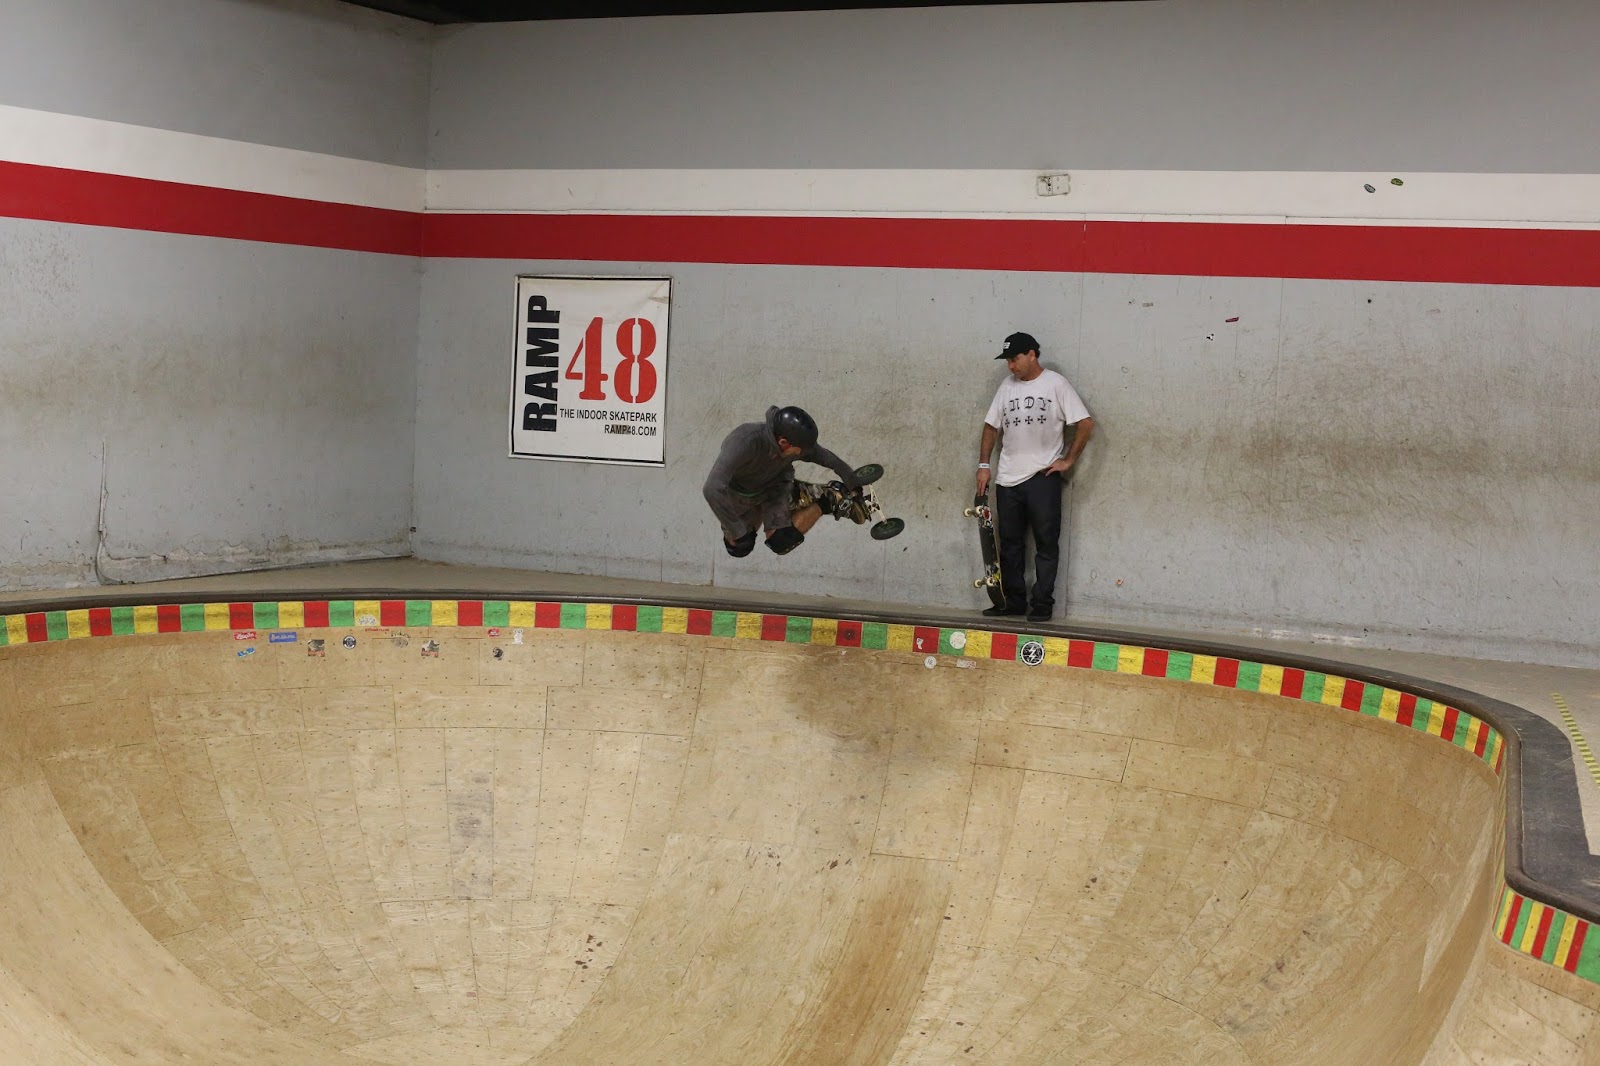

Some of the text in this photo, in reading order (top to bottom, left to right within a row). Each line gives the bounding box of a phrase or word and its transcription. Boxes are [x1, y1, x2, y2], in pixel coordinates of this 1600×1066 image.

[523, 295, 560, 432] RAMP
[565, 316, 657, 404] 48
[559, 408, 657, 422] THE INDOOR SKATEPARK
[1003, 396, 1052, 416] NDY
[604, 424, 656, 436] RAMP48.COM
